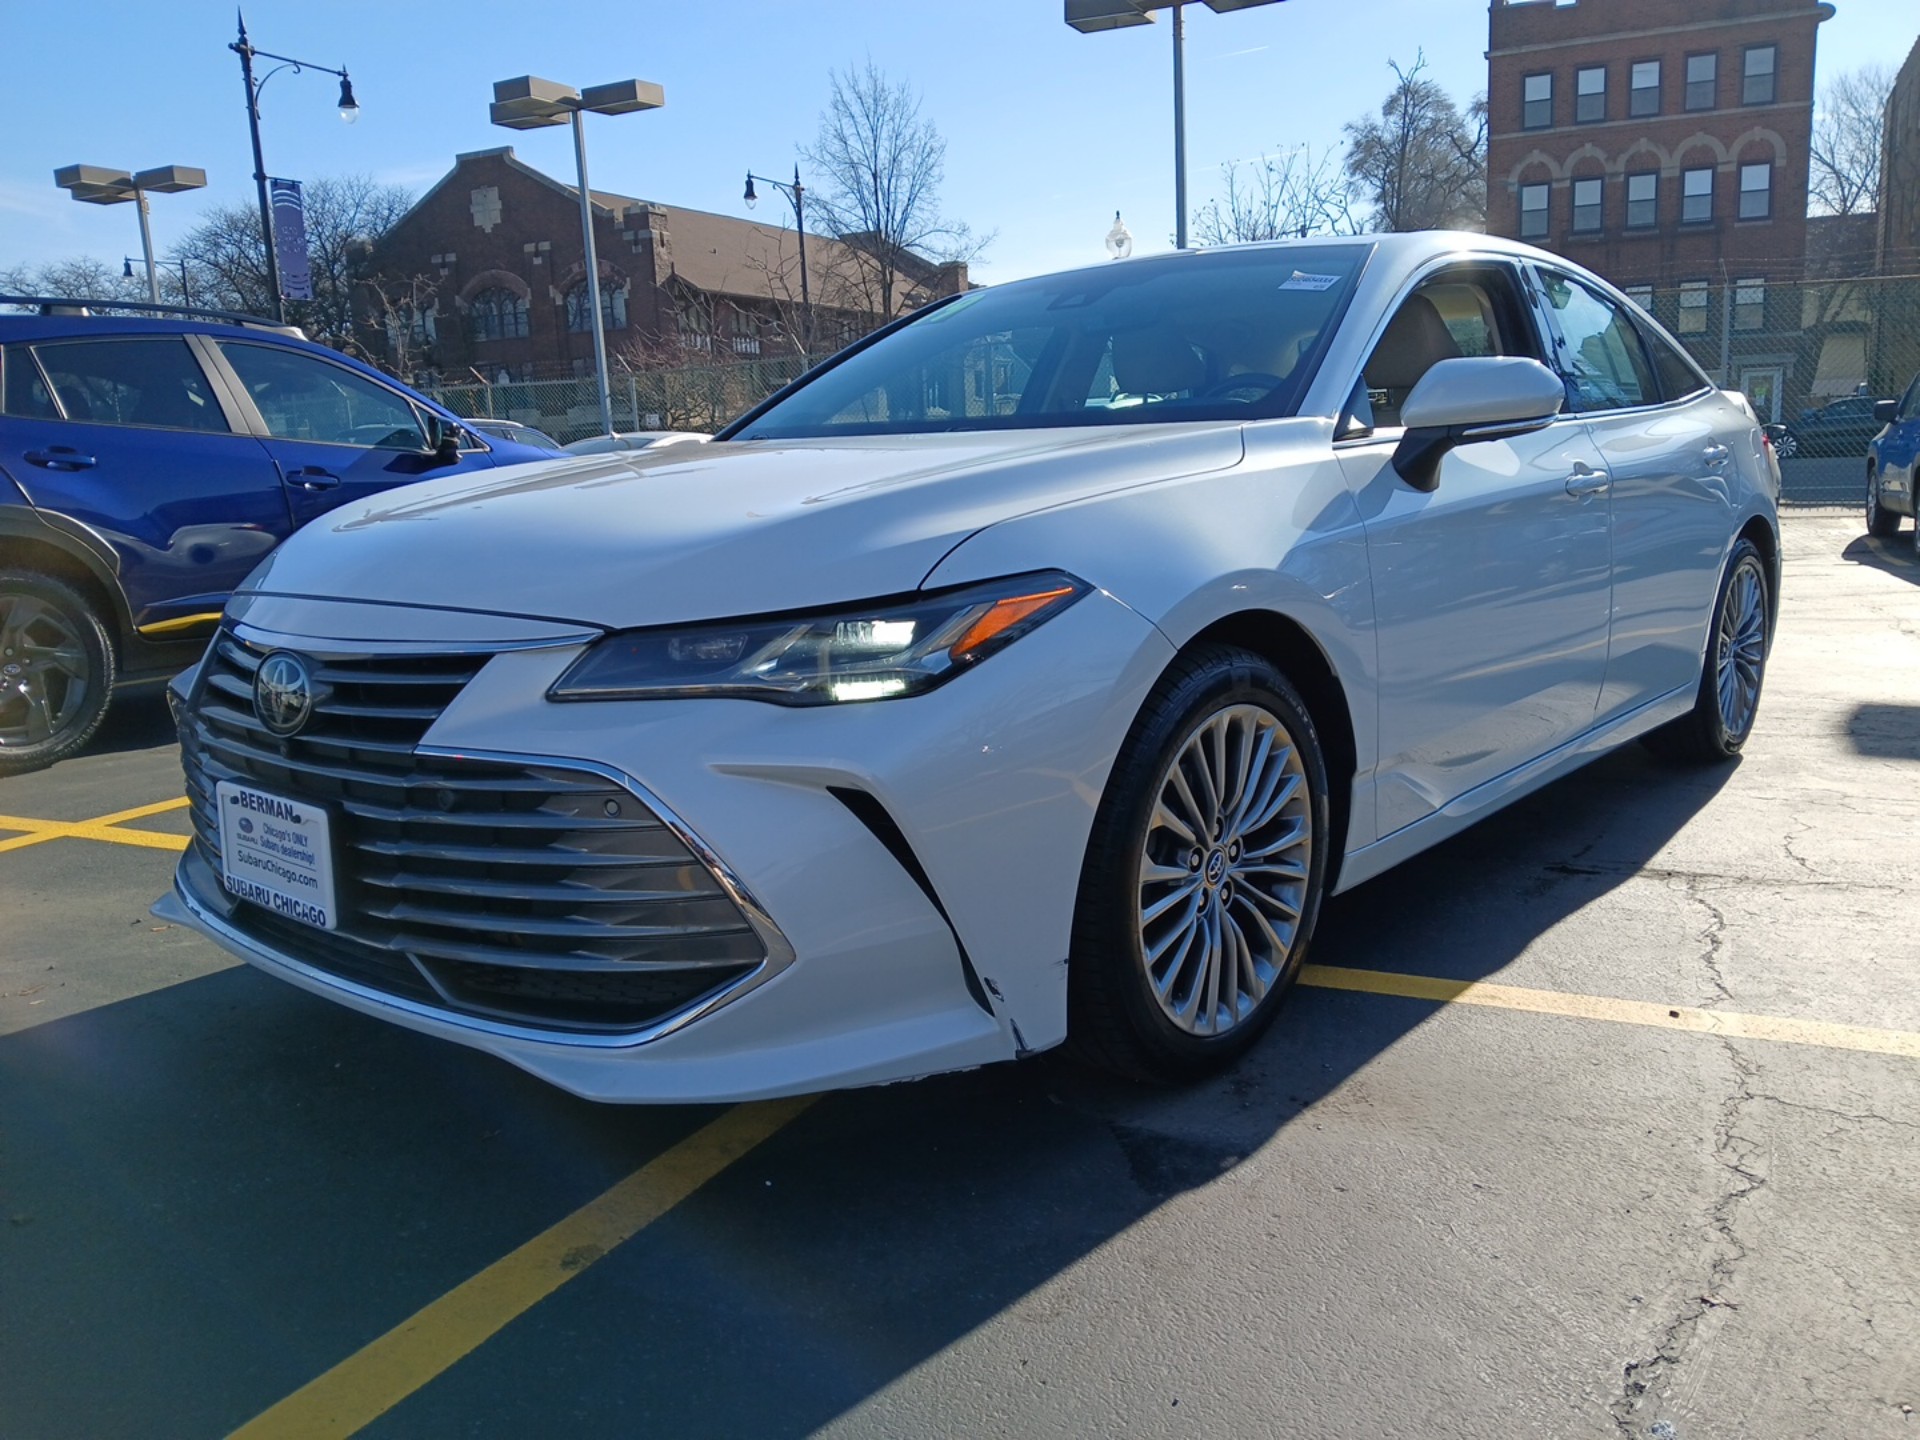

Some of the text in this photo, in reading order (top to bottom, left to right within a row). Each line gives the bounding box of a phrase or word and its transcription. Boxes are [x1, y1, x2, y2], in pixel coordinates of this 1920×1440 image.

[240, 791, 293, 822] BERMAN
[260, 836, 280, 854] Subaru
[263, 822, 308, 847] Chicago's ONLY
[237, 850, 318, 889] SubaruChicago.com
[227, 876, 326, 927] SUBARU CHICAGO
